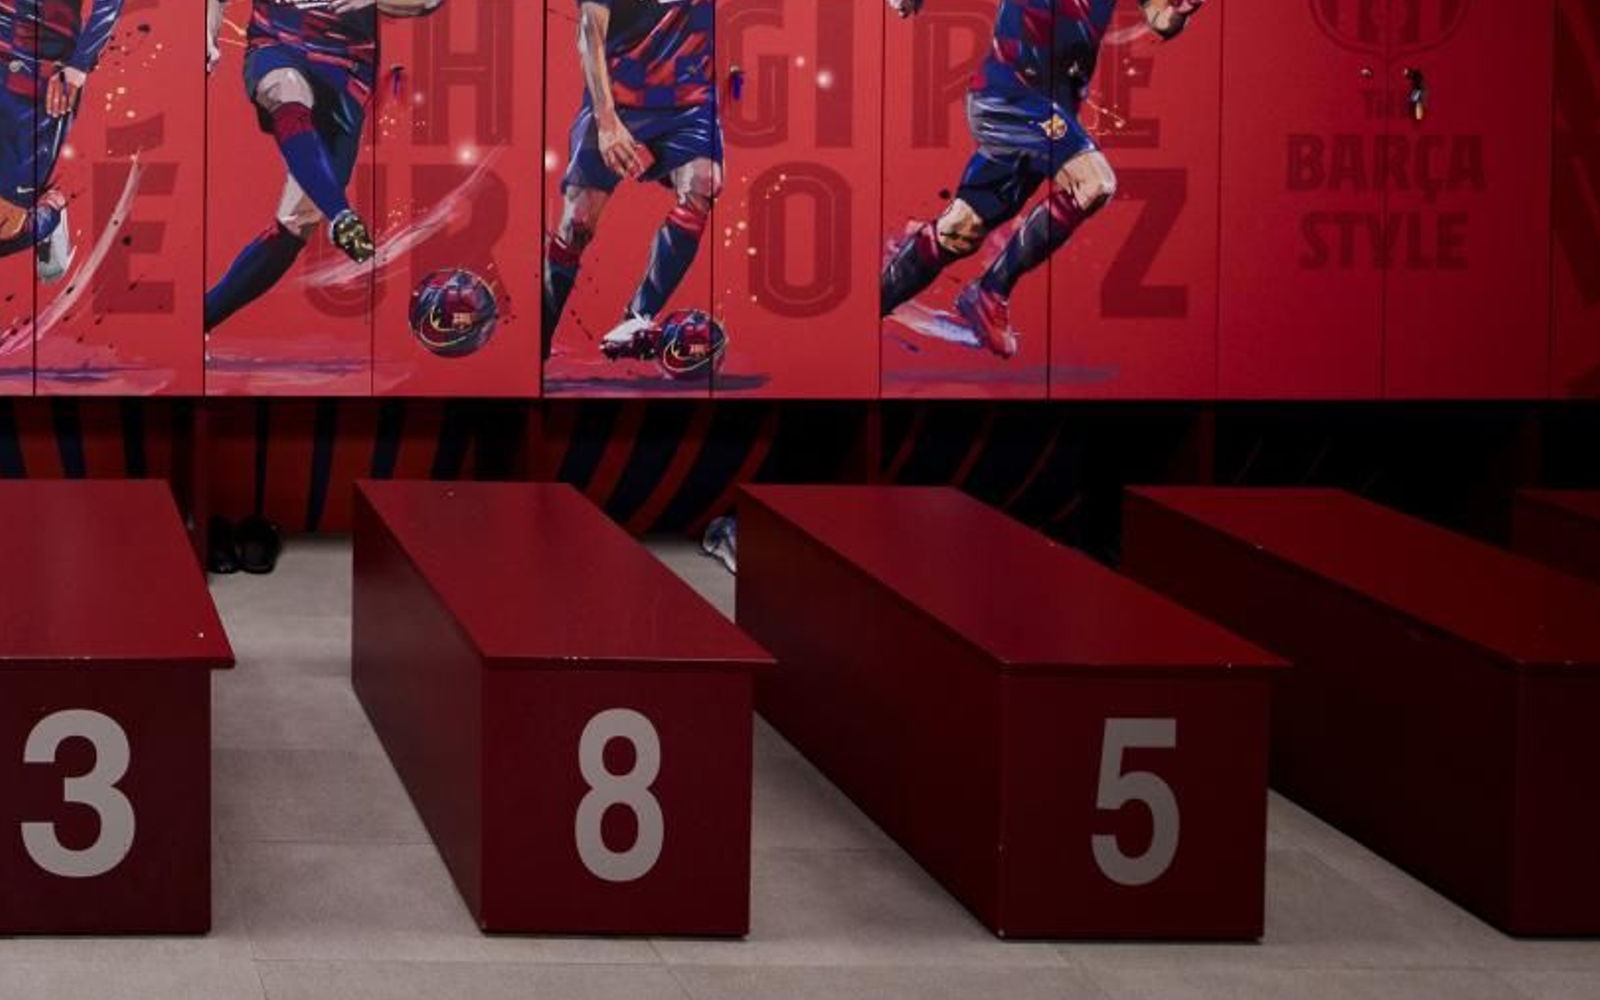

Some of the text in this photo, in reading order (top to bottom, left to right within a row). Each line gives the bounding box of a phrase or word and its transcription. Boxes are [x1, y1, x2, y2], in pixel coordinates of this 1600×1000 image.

[1286, 134, 1488, 204] BARÇA
[1299, 211, 1470, 270] STYLE
[20, 708, 137, 878] 3
[574, 708, 665, 882] 8
[1090, 717, 1181, 886] 5
